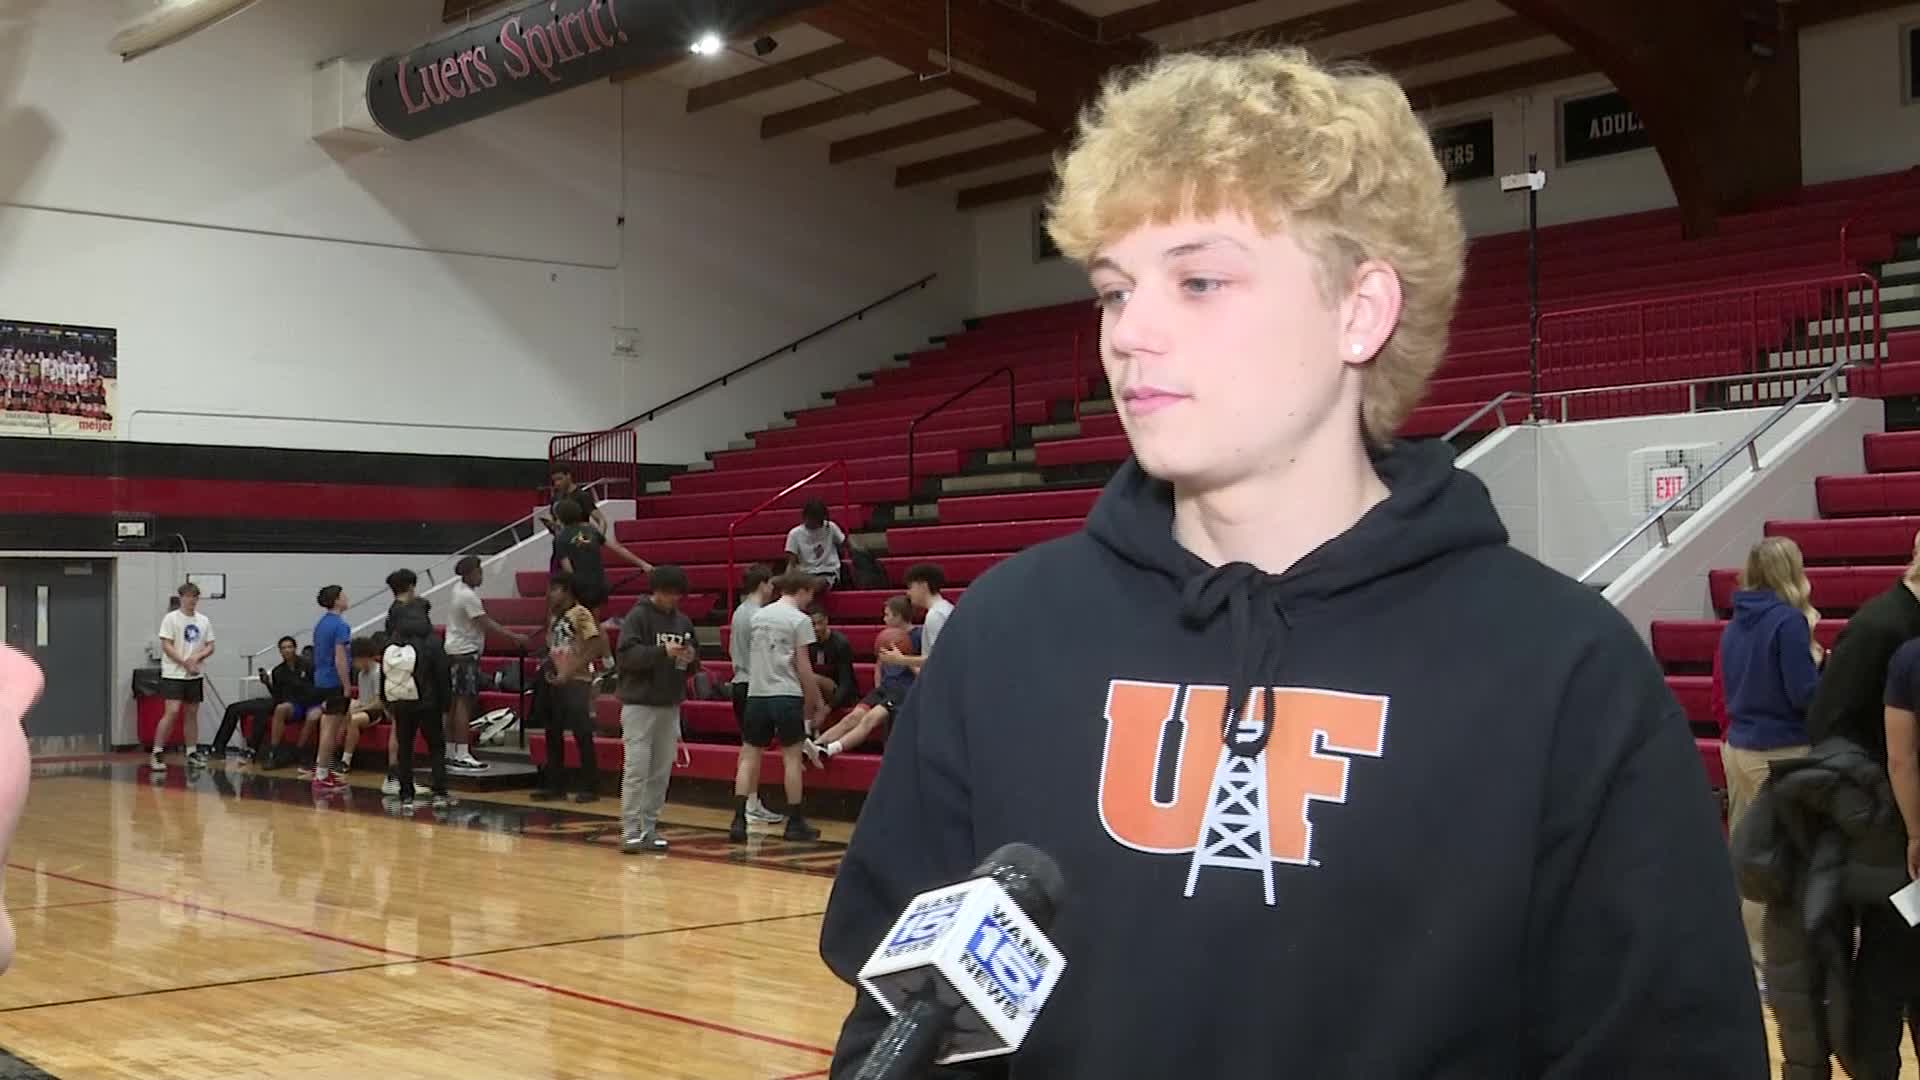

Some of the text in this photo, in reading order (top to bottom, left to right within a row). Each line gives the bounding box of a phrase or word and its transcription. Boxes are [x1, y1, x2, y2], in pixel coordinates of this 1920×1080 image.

[398, 0, 629, 114] Luers Spirit!
[78, 419, 112, 432] meijer
[1656, 476, 1682, 498] EXIT
[889, 901, 963, 946] 15
[915, 890, 970, 912] WANE
[965, 914, 1043, 1006] 15
[992, 903, 1050, 968] WANE
[958, 952, 1019, 1021] NEWS
